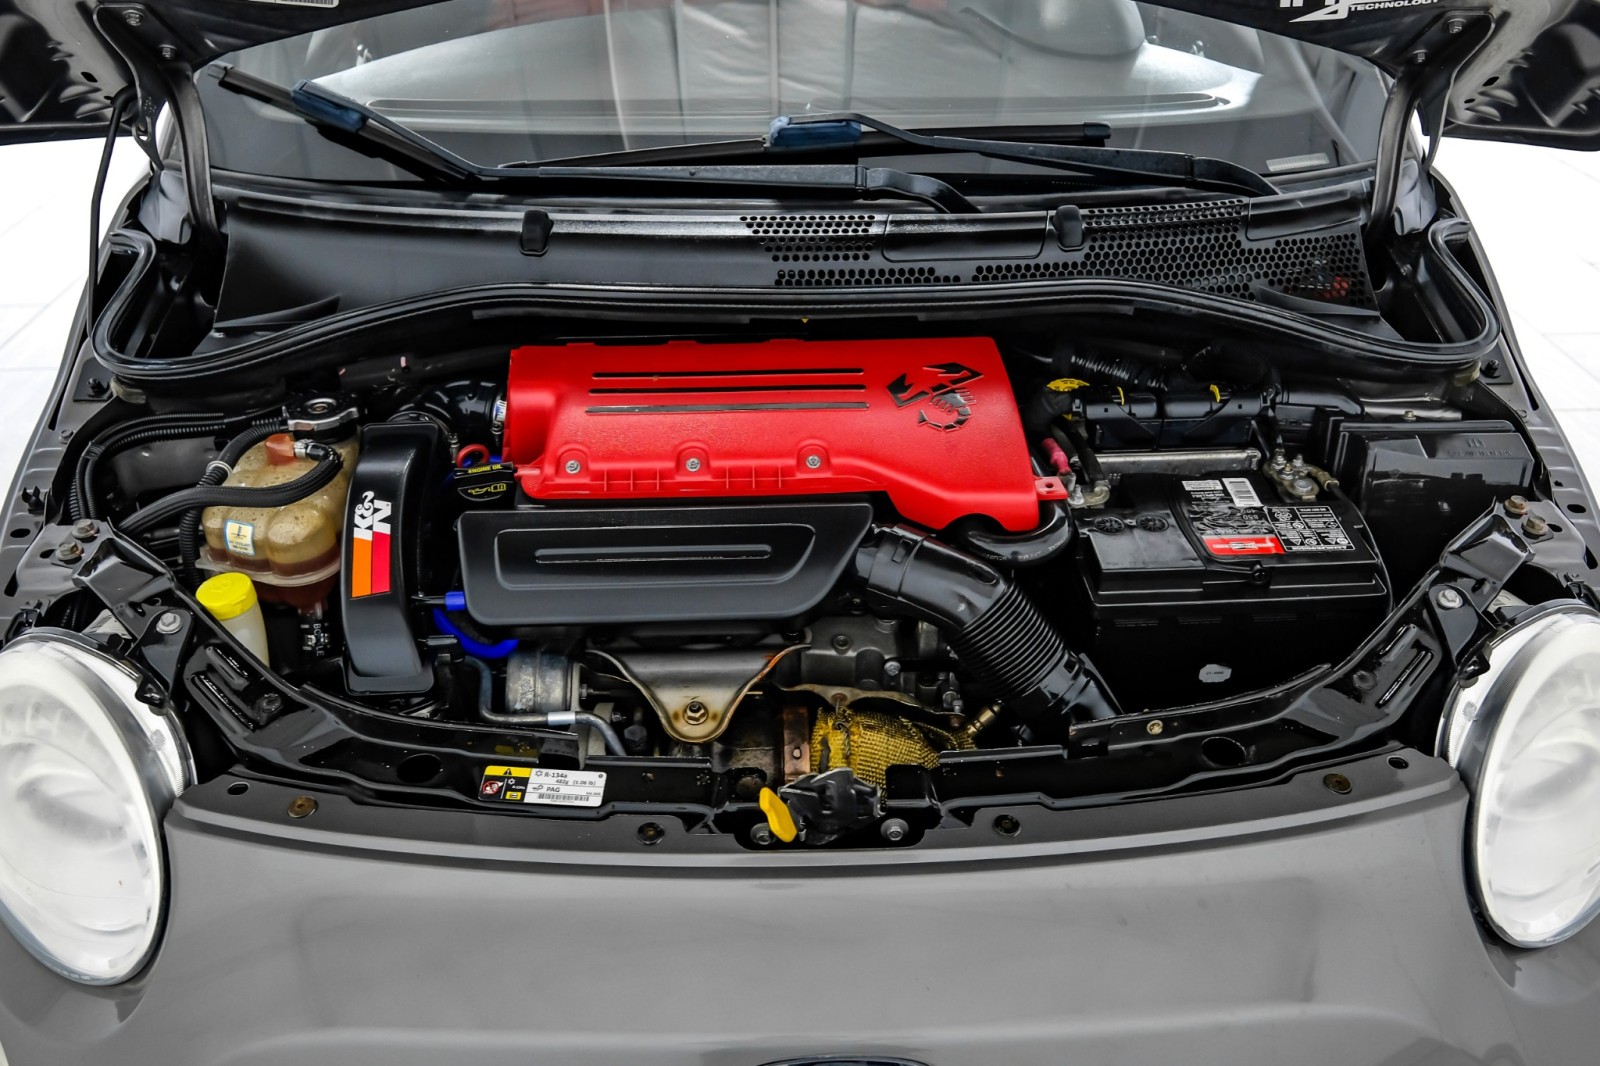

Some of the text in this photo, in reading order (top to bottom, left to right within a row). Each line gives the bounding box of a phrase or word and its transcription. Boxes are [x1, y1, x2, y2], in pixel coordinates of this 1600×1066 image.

[468, 465, 491, 474] ENGINE
[354, 491, 392, 541] K&N
[544, 771, 568, 779] R-134a
